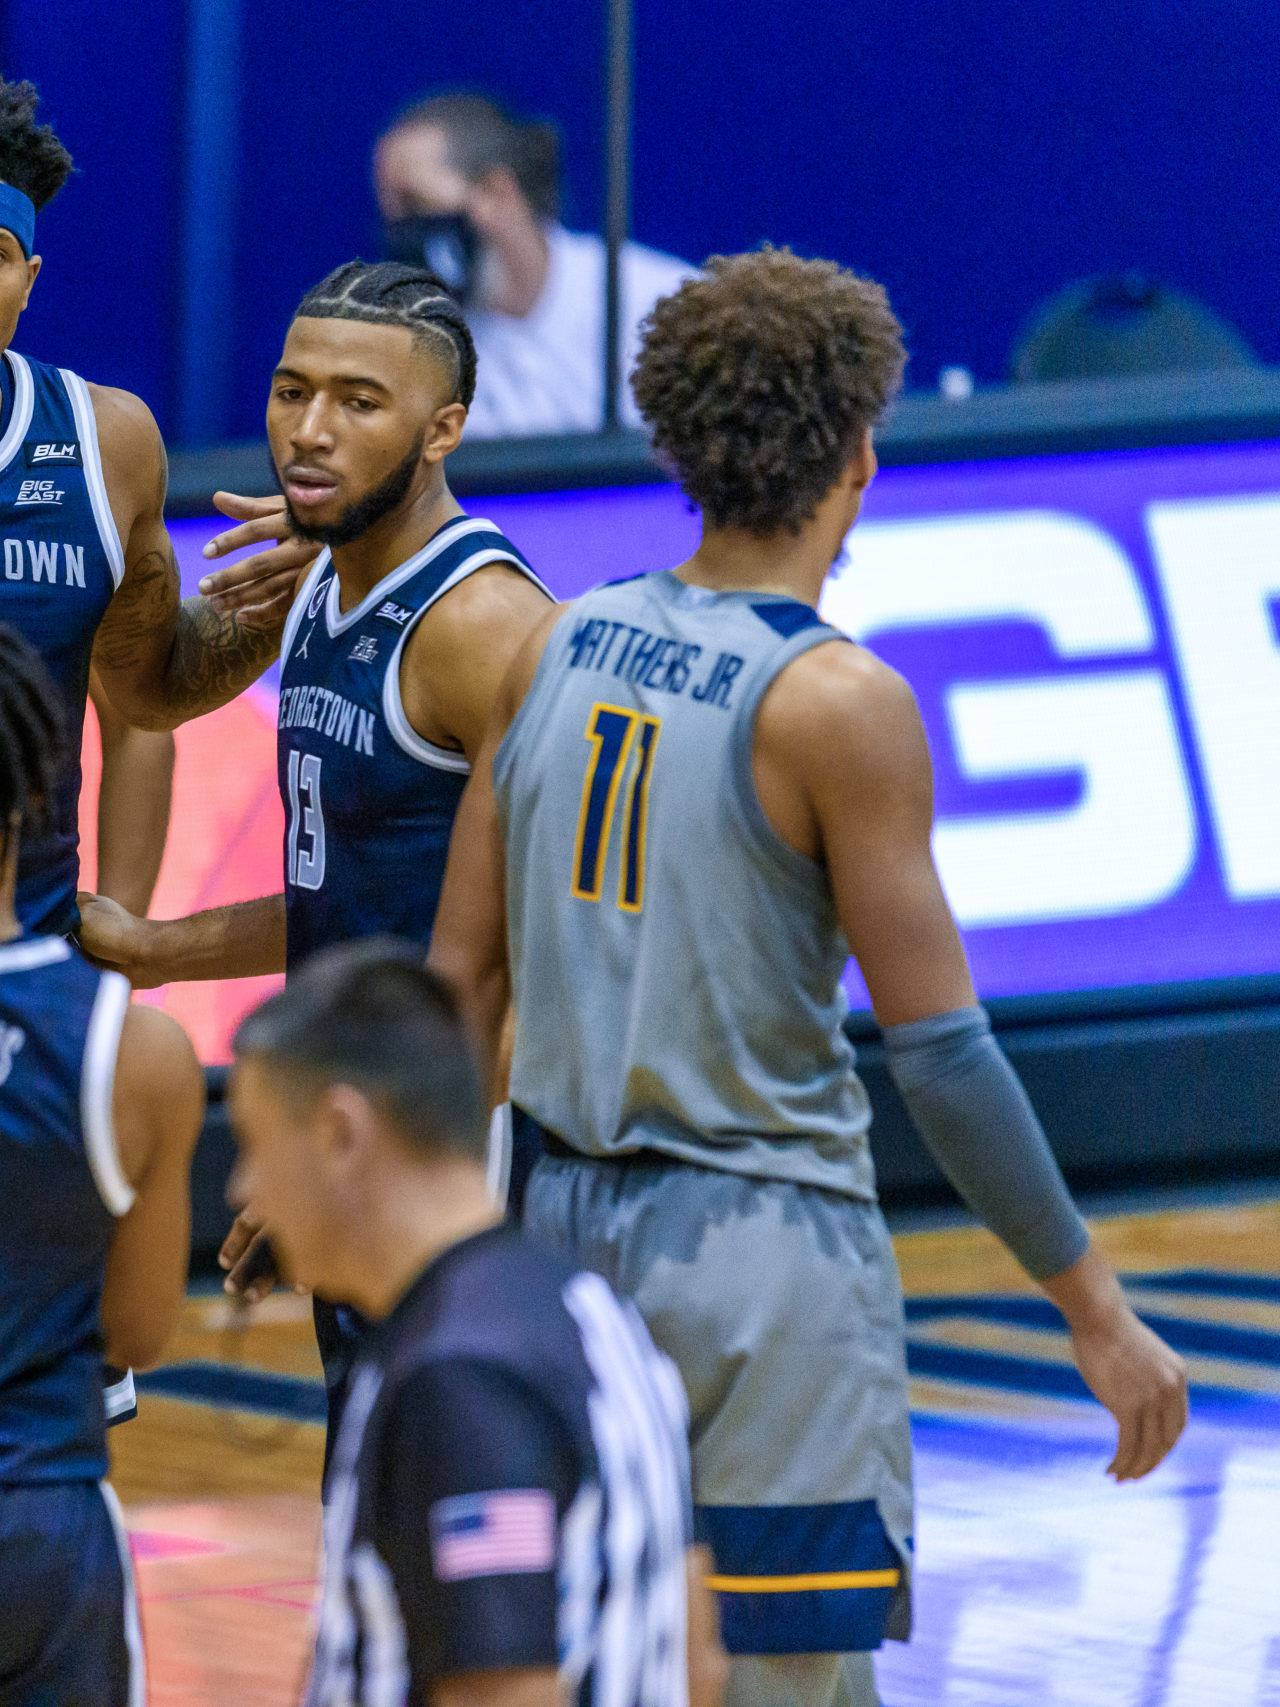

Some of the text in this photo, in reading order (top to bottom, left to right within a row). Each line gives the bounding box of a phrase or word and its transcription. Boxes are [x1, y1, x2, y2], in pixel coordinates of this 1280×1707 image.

[33, 443, 77, 457] BLM
[20, 480, 56, 491] BIG
[17, 490, 66, 501] EAST
[380, 601, 413, 622] BLM
[572, 702, 663, 914] 11
[288, 749, 326, 891] 13
